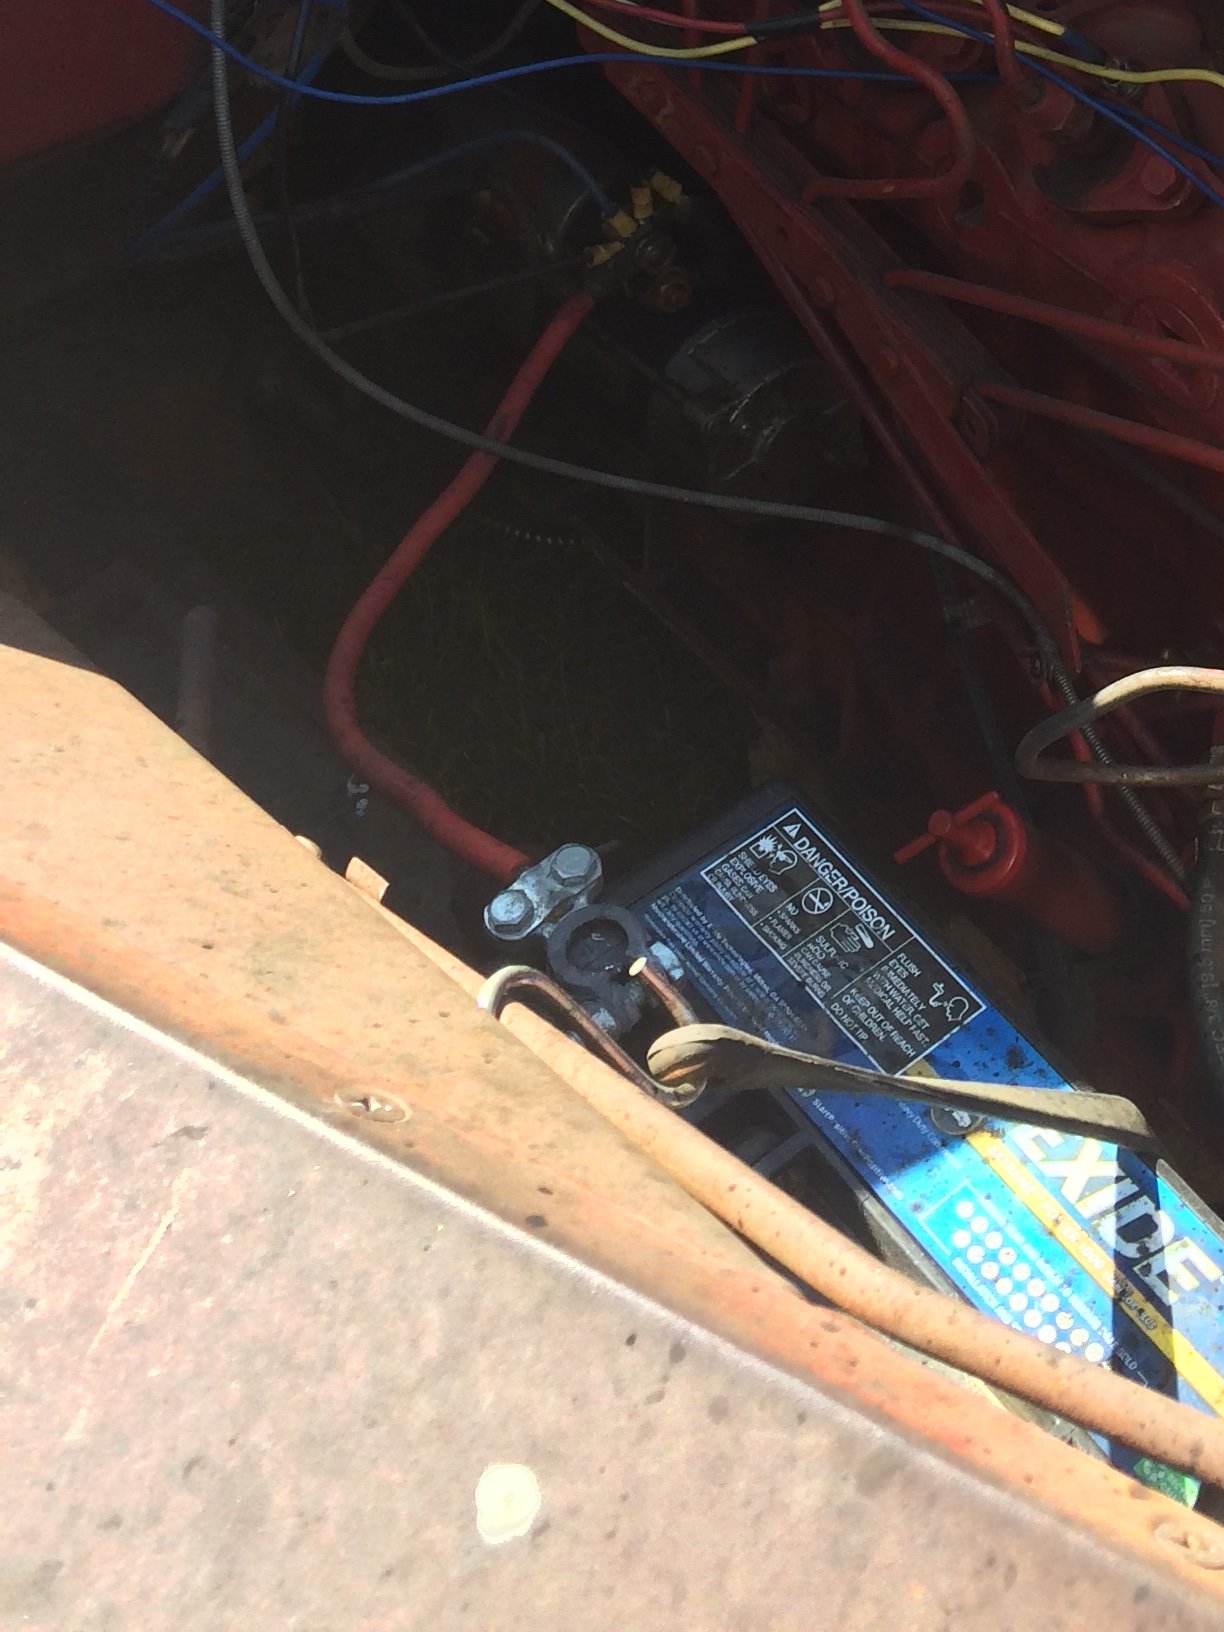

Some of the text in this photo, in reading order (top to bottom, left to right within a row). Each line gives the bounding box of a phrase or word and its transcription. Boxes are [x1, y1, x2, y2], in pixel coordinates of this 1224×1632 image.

[720, 862, 744, 887] GASES
[728, 856, 764, 894] EXPLOSIVE
[758, 872, 778, 893] EYES
[792, 837, 896, 940] DANGER/POISON
[785, 902, 799, 916] NO
[769, 917, 792, 941] FLAMES
[814, 934, 849, 971] SULFUIC
[896, 951, 921, 978] FLUSH
[888, 957, 909, 979] EYES
[841, 993, 855, 1007] OF
[829, 1001, 845, 1017] DO
[839, 1012, 857, 1031] NOT
[848, 986, 916, 1058] KEEP OUT OF REACH
[891, 1006, 912, 1028] HELP
[1005, 1127, 1223, 1307] EXIDE
